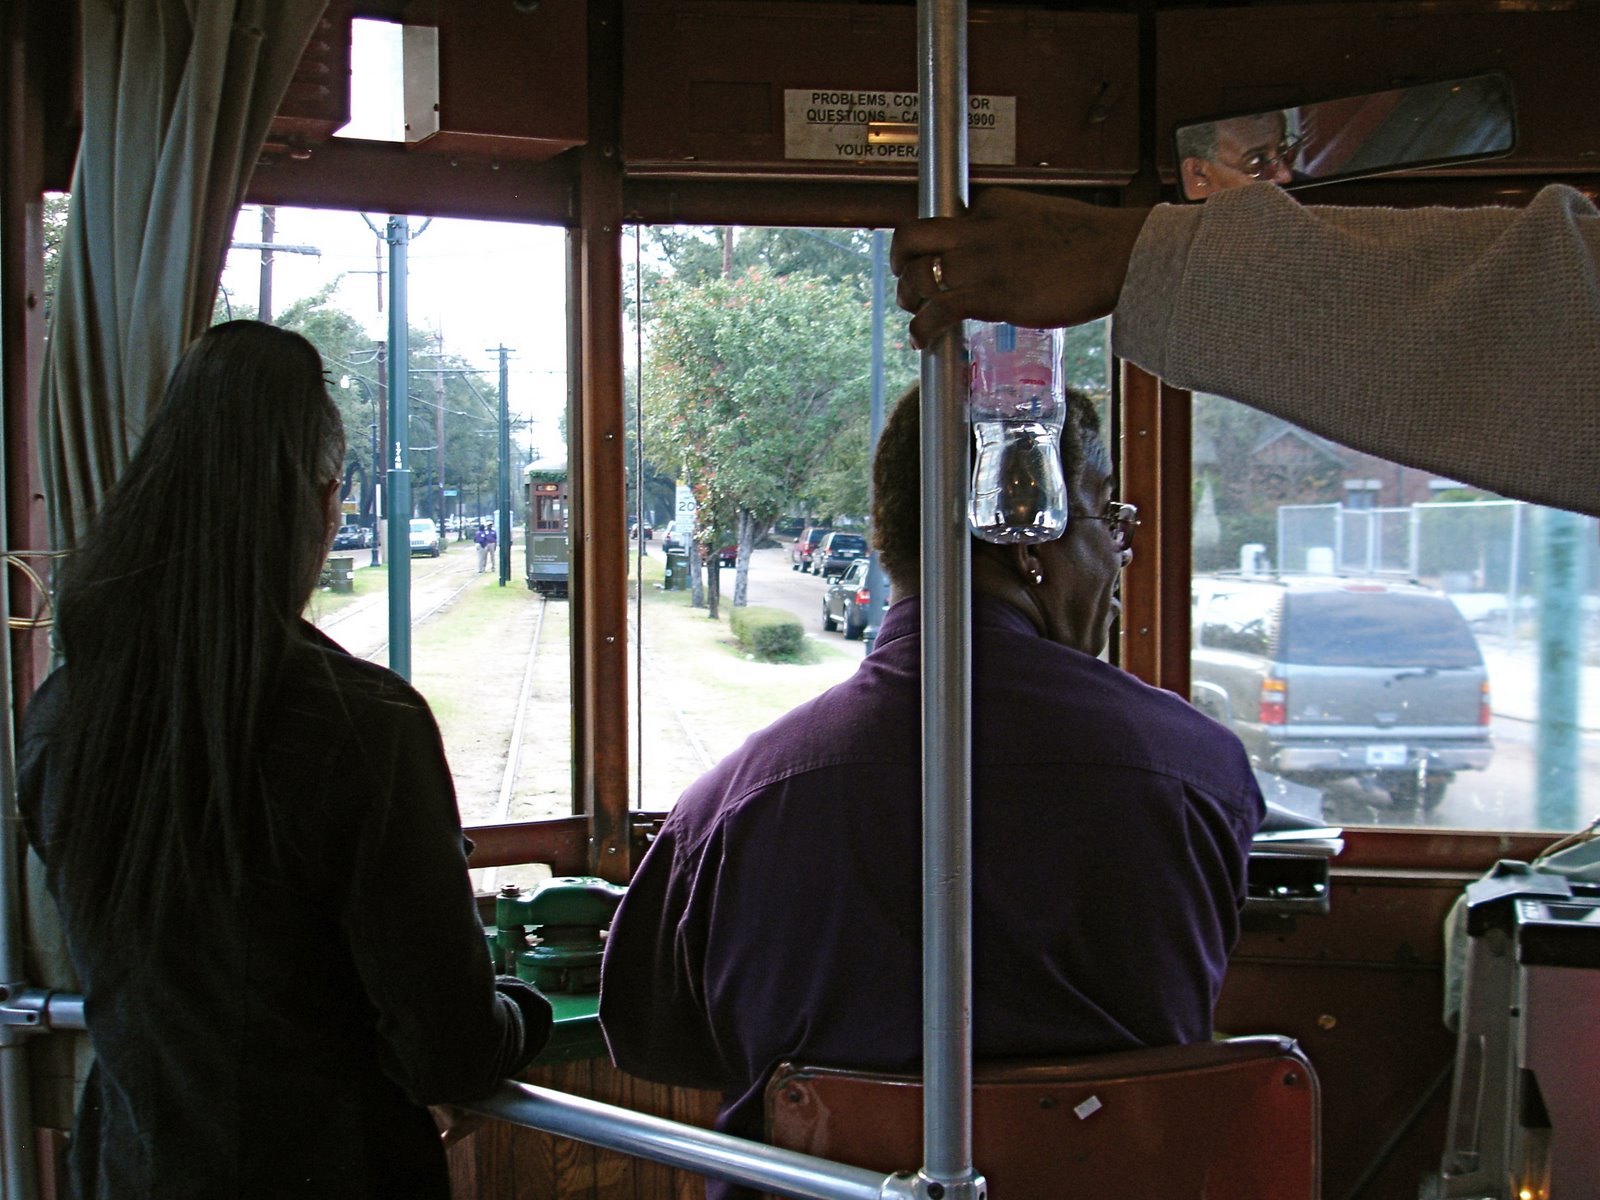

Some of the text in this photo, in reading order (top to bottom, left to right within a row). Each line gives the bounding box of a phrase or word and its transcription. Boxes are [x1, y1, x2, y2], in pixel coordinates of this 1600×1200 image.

[812, 93, 889, 107] PROBLEMS,
[970, 97, 990, 110] OR
[807, 109, 886, 122] QUESTIONS
[836, 143, 873, 156] YOUR
[678, 501, 696, 512] 20
